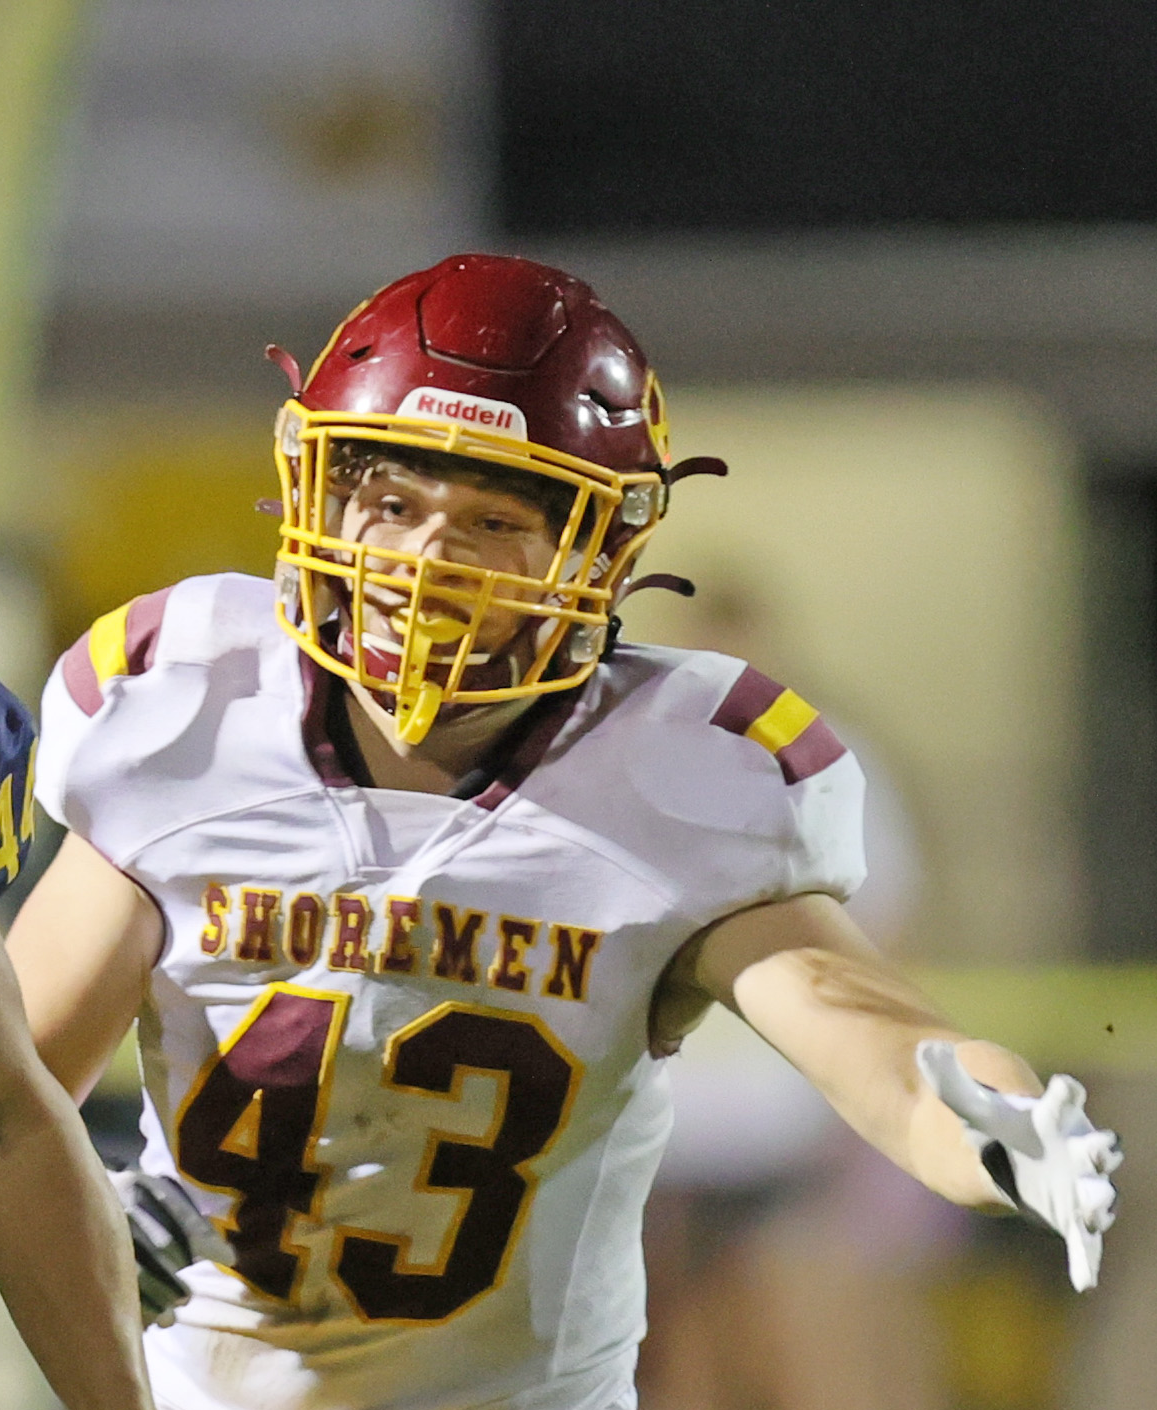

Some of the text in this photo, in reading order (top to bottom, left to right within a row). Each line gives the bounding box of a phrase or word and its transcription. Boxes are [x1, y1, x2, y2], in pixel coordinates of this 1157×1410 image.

[417, 394, 514, 429] Riddell
[200, 881, 605, 1002] SHOREMEN
[177, 981, 585, 1326] 43
